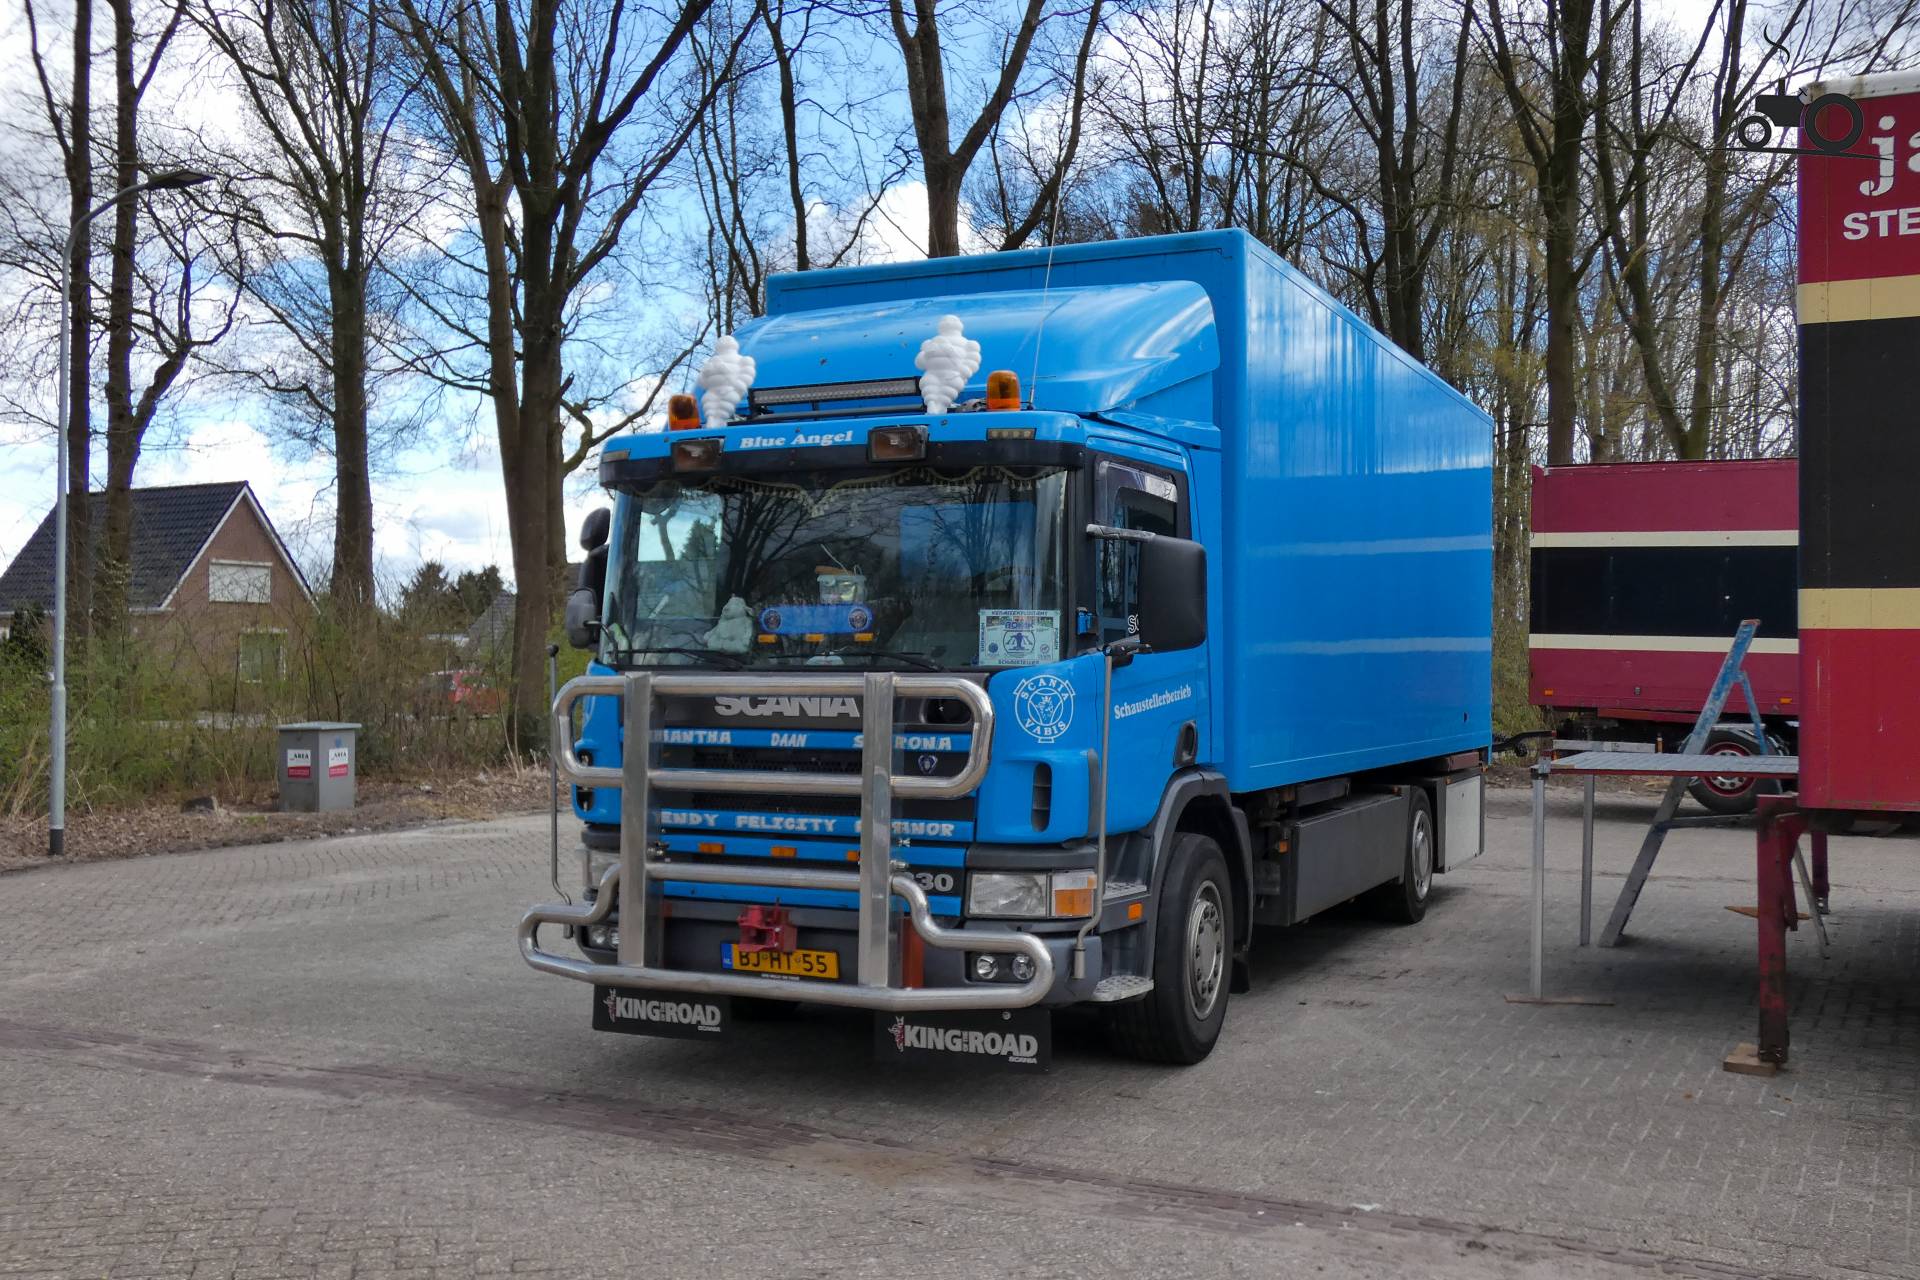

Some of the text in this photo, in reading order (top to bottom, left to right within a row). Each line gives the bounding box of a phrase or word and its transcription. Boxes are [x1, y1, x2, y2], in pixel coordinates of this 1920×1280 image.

[1843, 207, 1920, 241] STE
[740, 430, 853, 448] Blue Angel
[1128, 614, 1139, 633] S
[1020, 677, 1070, 701] SCANIA
[714, 696, 860, 718] SCANIA
[1114, 684, 1192, 720] Schaustellerbetrieb
[1024, 720, 1067, 736] VABIS
[770, 732, 807, 748] DAAN
[735, 815, 837, 833] FELICITY
[904, 1025, 962, 1052] KING
[968, 1031, 1038, 1057] ROAD
